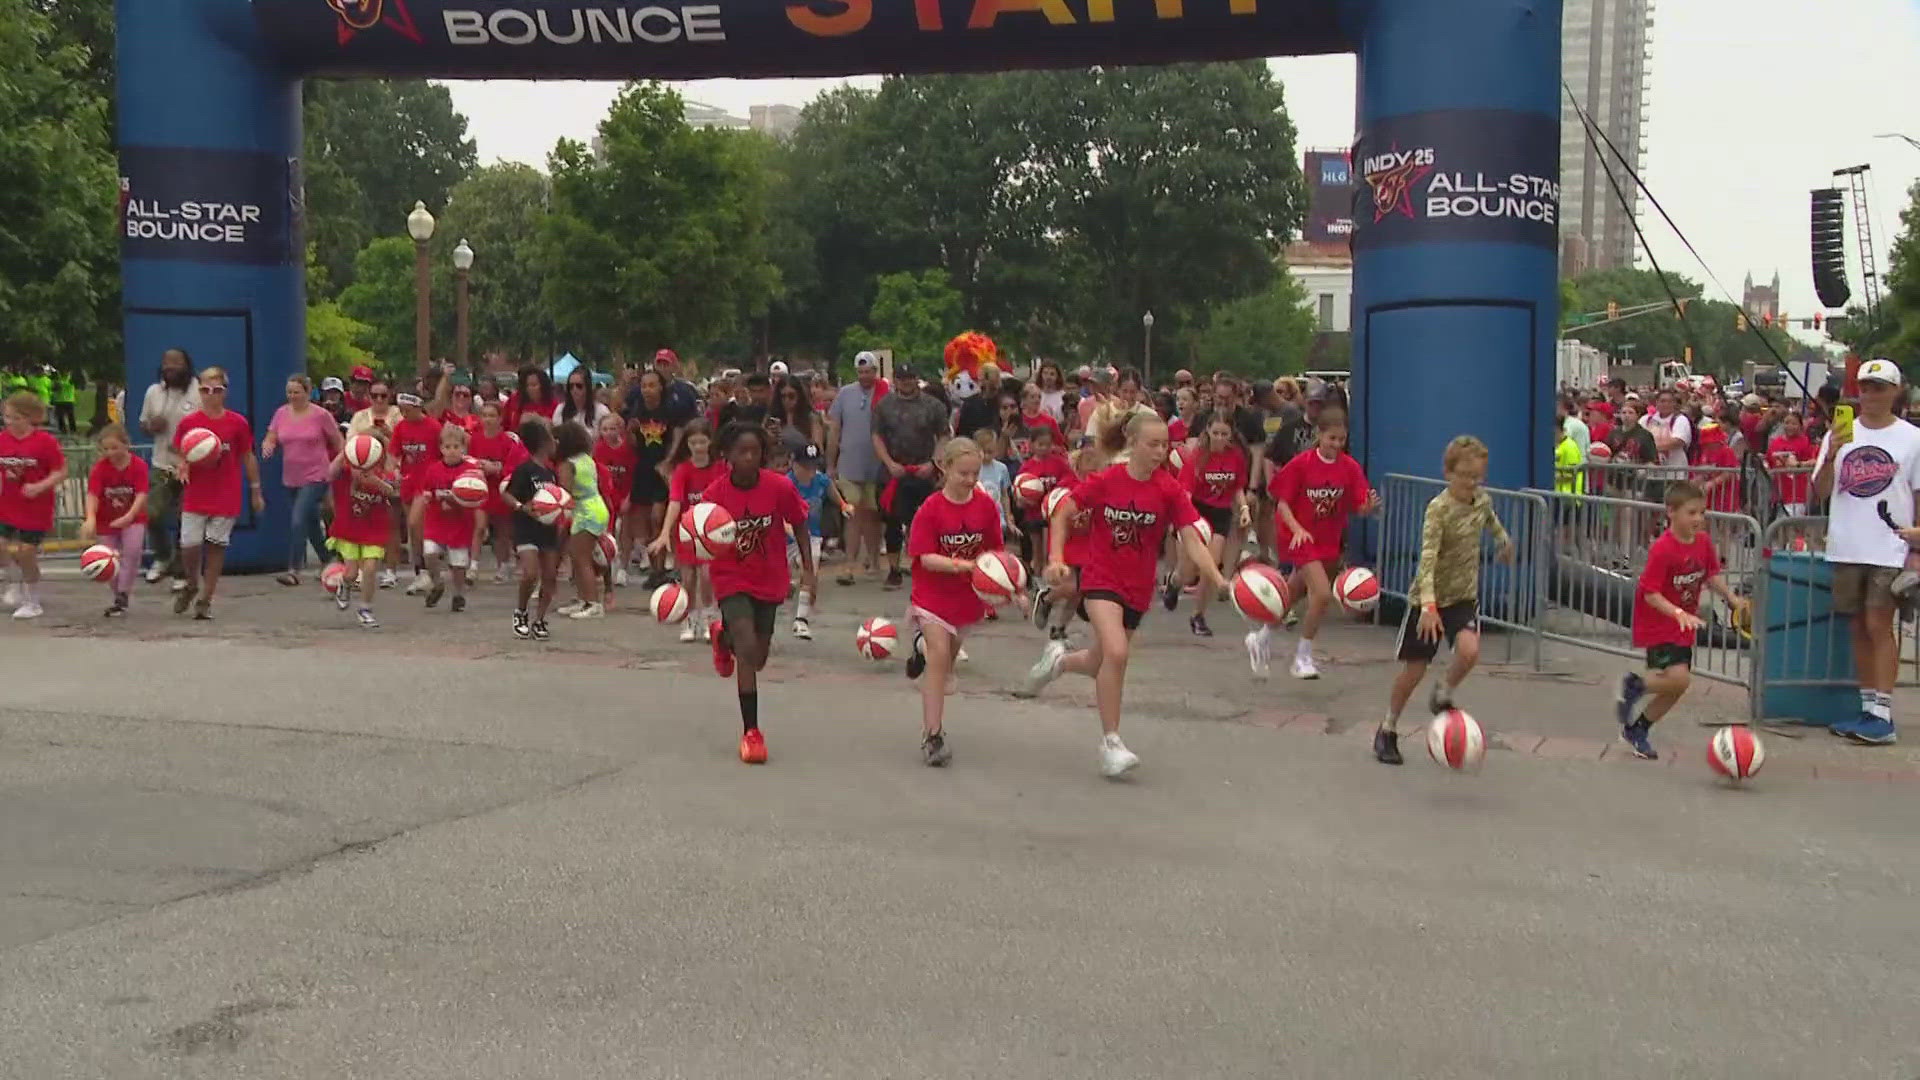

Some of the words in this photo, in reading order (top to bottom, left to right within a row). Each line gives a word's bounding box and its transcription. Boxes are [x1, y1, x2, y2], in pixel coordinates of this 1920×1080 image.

[442, 4, 726, 45] BOUNCE
[1363, 150, 1413, 175] INDY
[1414, 147, 1435, 167] 25
[127, 198, 261, 222] ALL-STAR
[1427, 195, 1554, 225] BOUNCE
[127, 219, 245, 242] BOUNCE
[1306, 487, 1337, 498] INDY
[1104, 505, 1144, 522] INDY
[940, 533, 975, 545] INDY
